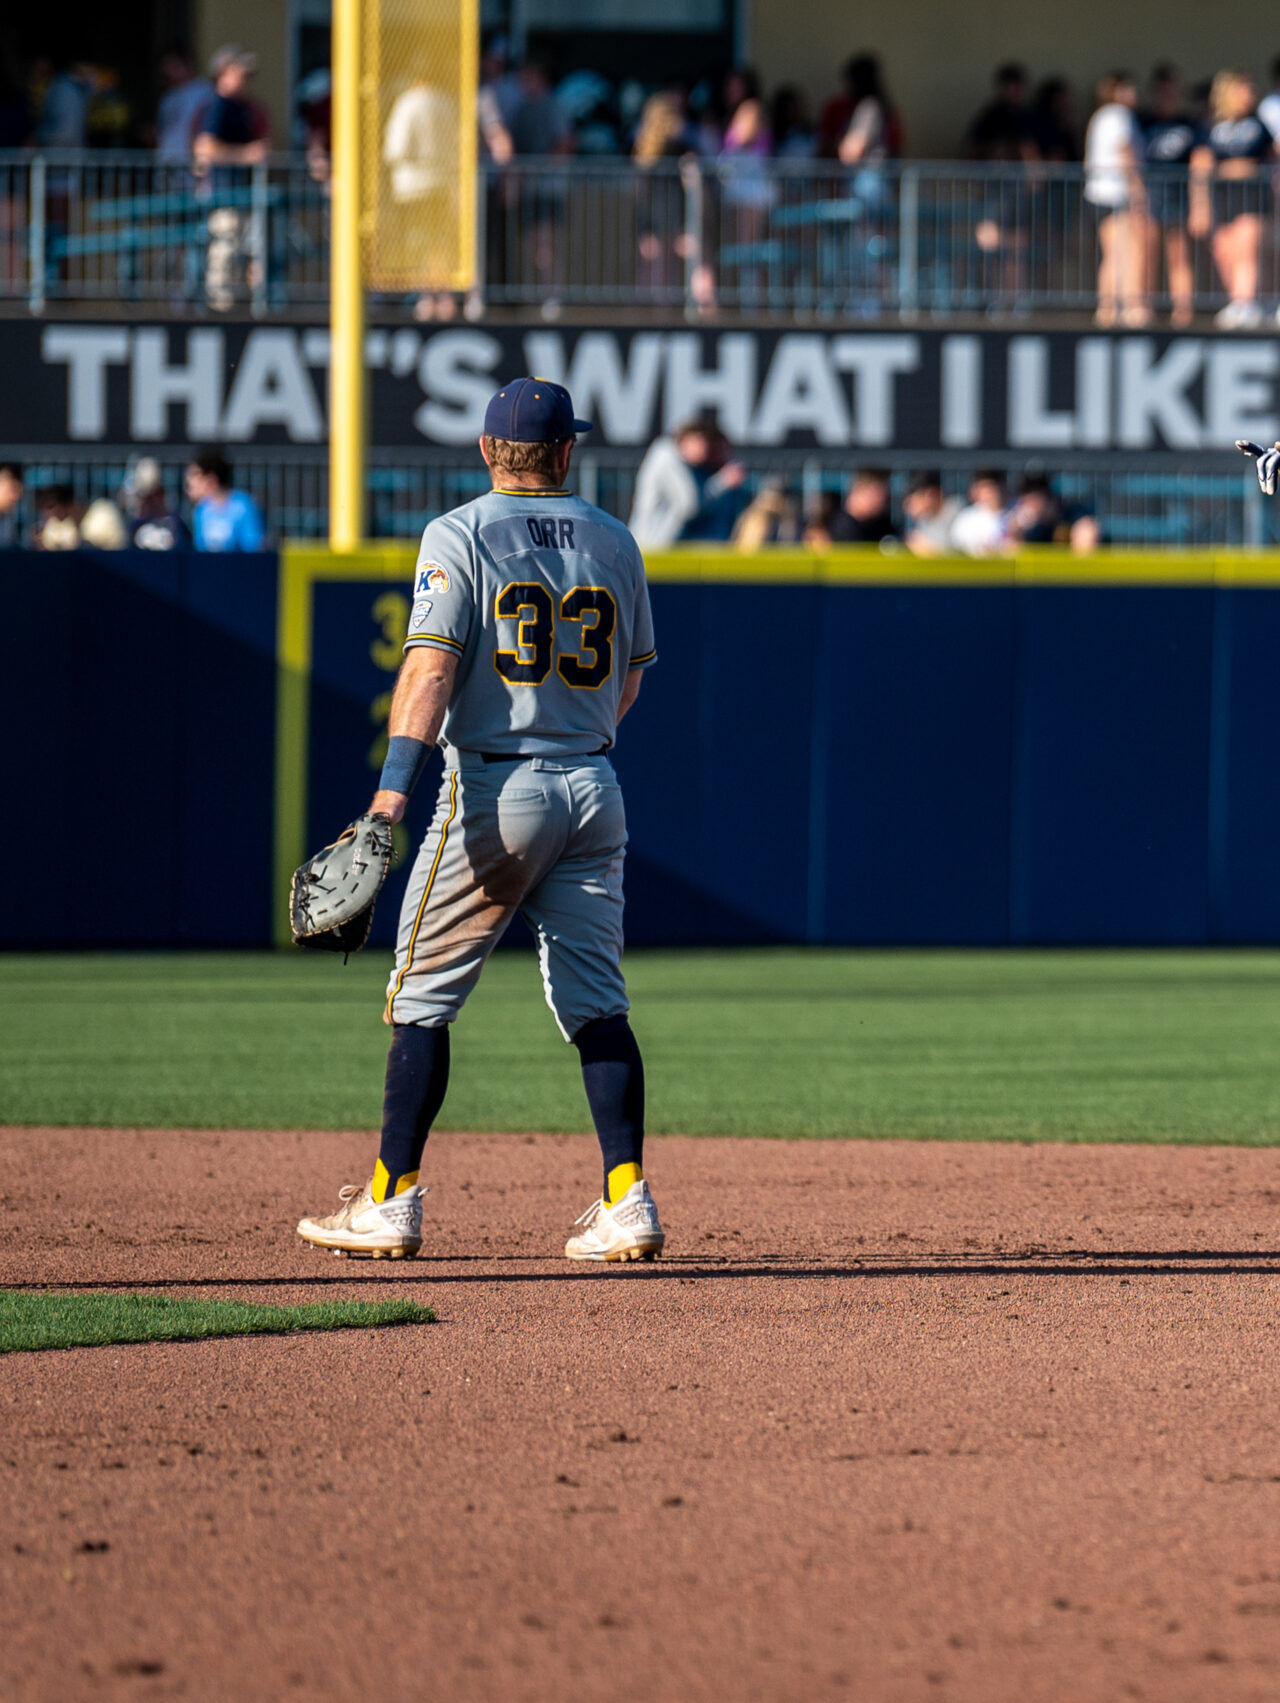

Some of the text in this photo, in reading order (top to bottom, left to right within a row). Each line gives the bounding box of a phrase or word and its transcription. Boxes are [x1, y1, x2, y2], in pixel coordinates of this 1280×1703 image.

[41, 324, 503, 447] THA'S
[523, 329, 920, 448] WHAT
[940, 333, 983, 449] I
[526, 518, 575, 549] ORR
[416, 569, 436, 593] K
[493, 581, 617, 690] 33
